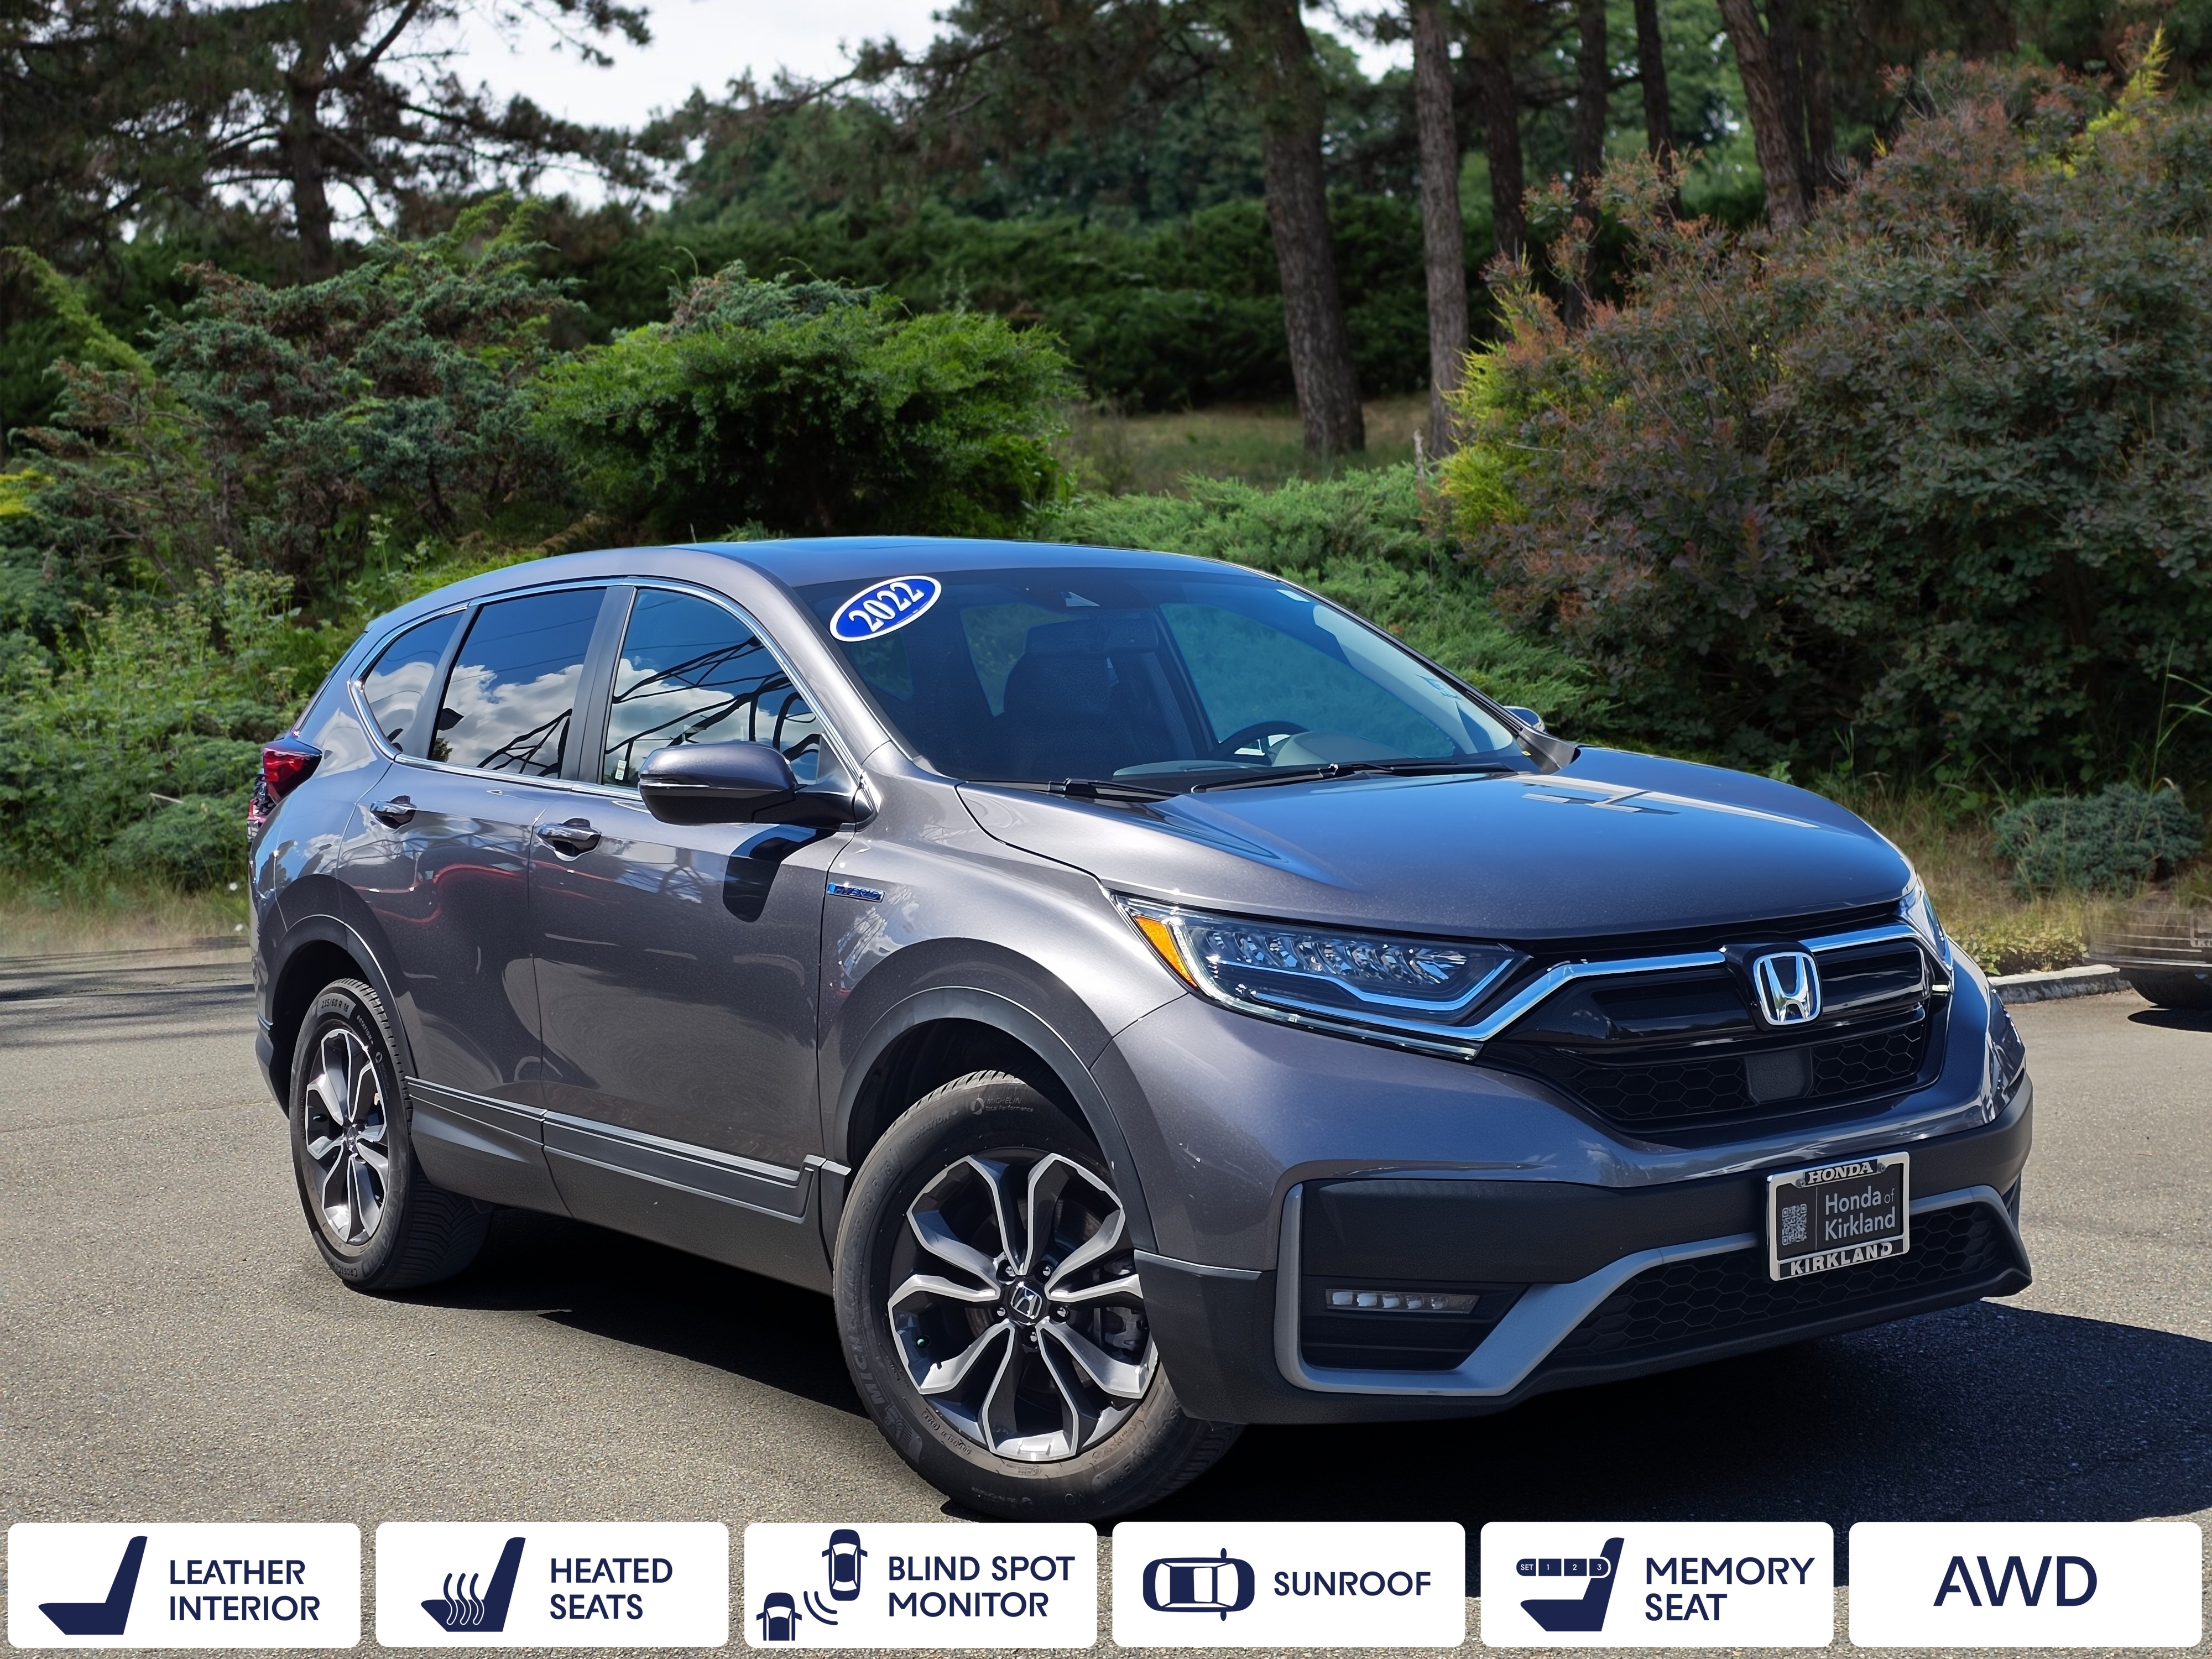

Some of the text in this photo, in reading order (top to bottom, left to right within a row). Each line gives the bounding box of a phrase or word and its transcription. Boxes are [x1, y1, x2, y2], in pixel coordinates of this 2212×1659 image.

[848, 581, 925, 632] 2022
[1808, 1162, 1874, 1184] HONDA
[1825, 1185, 1895, 1215] Honda of
[1825, 1206, 1895, 1241] Kirkland
[1790, 1242, 1893, 1276] KIRKLAND
